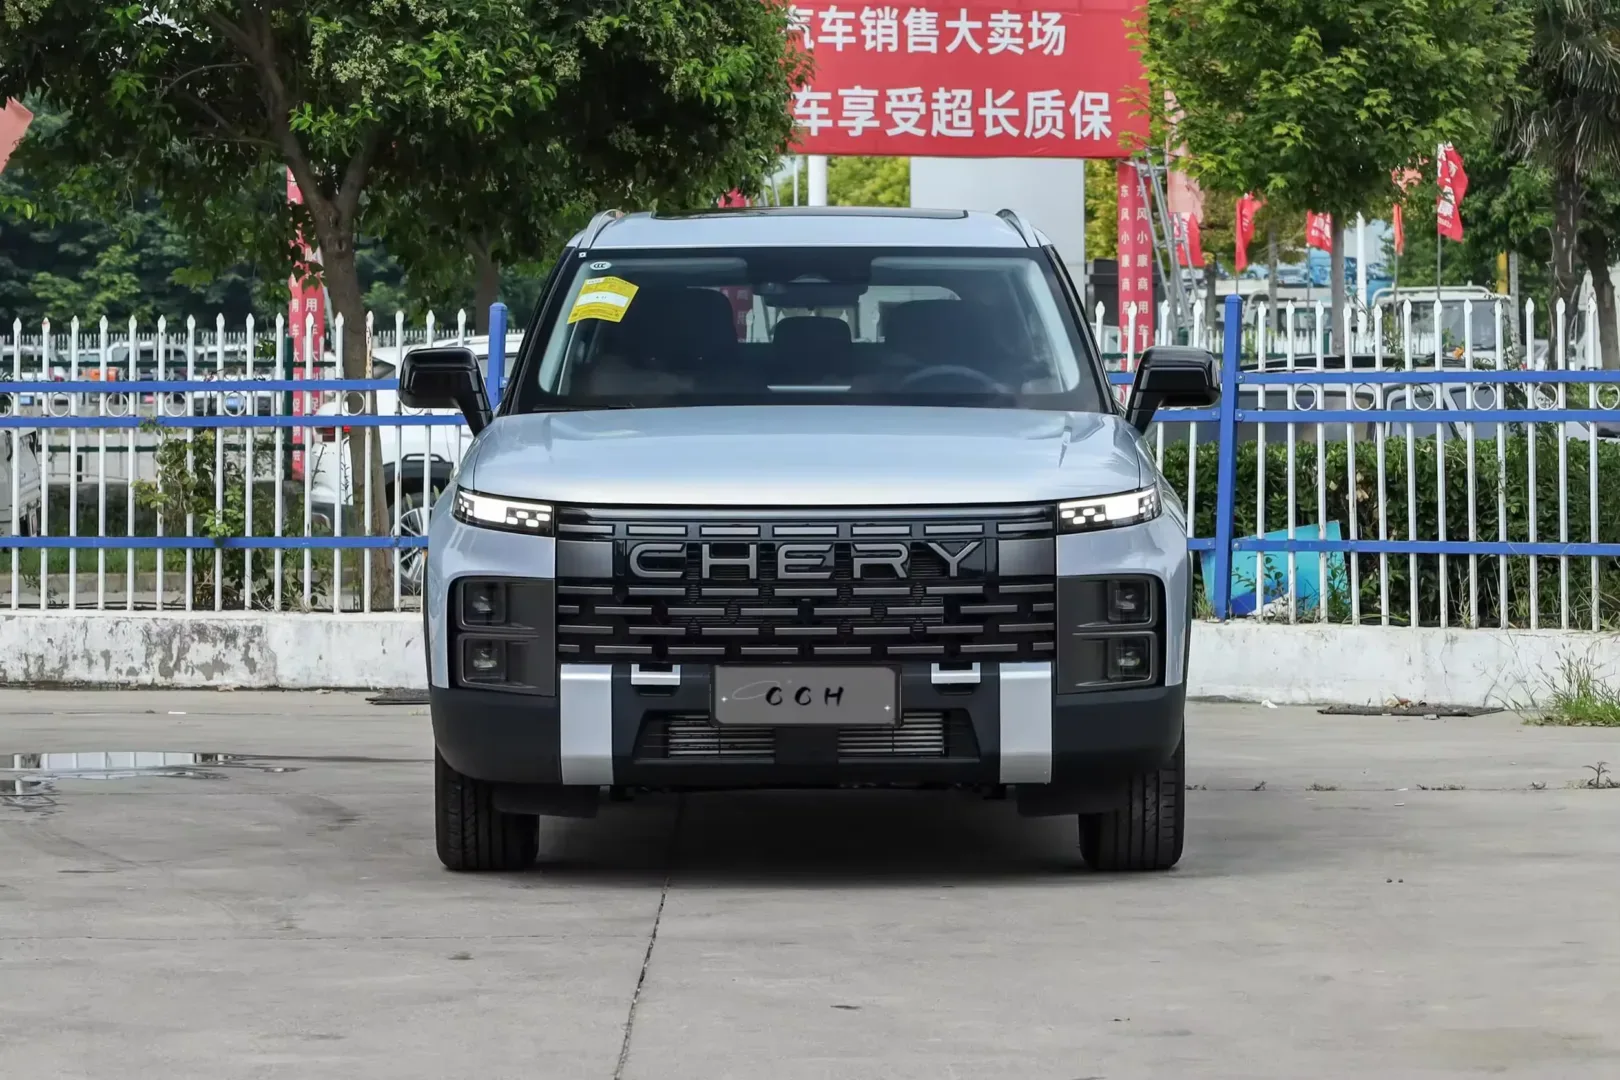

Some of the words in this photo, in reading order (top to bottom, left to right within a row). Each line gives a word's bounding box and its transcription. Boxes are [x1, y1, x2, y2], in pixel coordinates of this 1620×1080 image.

[791, 85, 1112, 141] 车享受超长质保
[629, 543, 983, 579] CHERY
